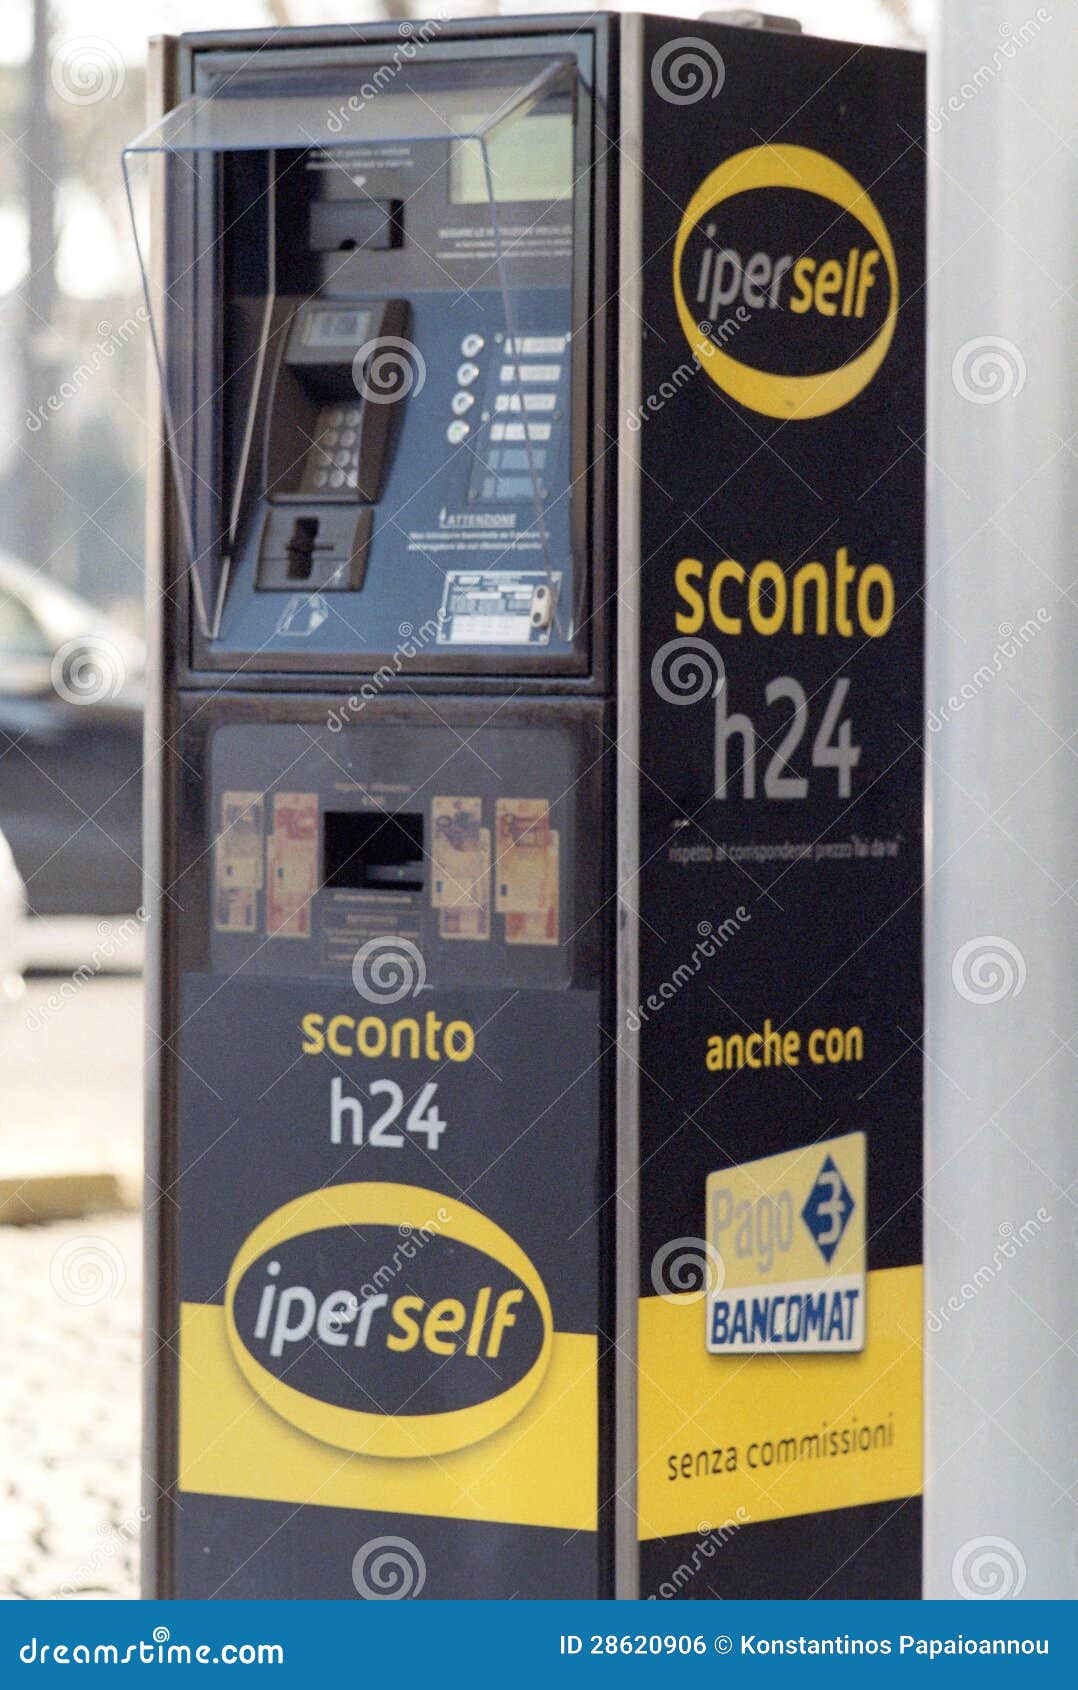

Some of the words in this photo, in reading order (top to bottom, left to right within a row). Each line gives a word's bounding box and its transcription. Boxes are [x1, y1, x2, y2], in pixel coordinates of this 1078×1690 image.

[695, 224, 879, 321] iperself
[674, 547, 895, 637] sconto
[714, 676, 862, 800] h24
[302, 1011, 475, 1062] sconto
[706, 1019, 799, 1071] anche
[807, 1025, 864, 1064] con
[331, 1077, 447, 1150] h24
[711, 1187, 793, 1273] Pago
[254, 1261, 523, 1358] iperself
[711, 1288, 860, 1345] BANCOMAT
[668, 1445, 737, 1481] senza
[746, 1412, 893, 1468] commissioni
